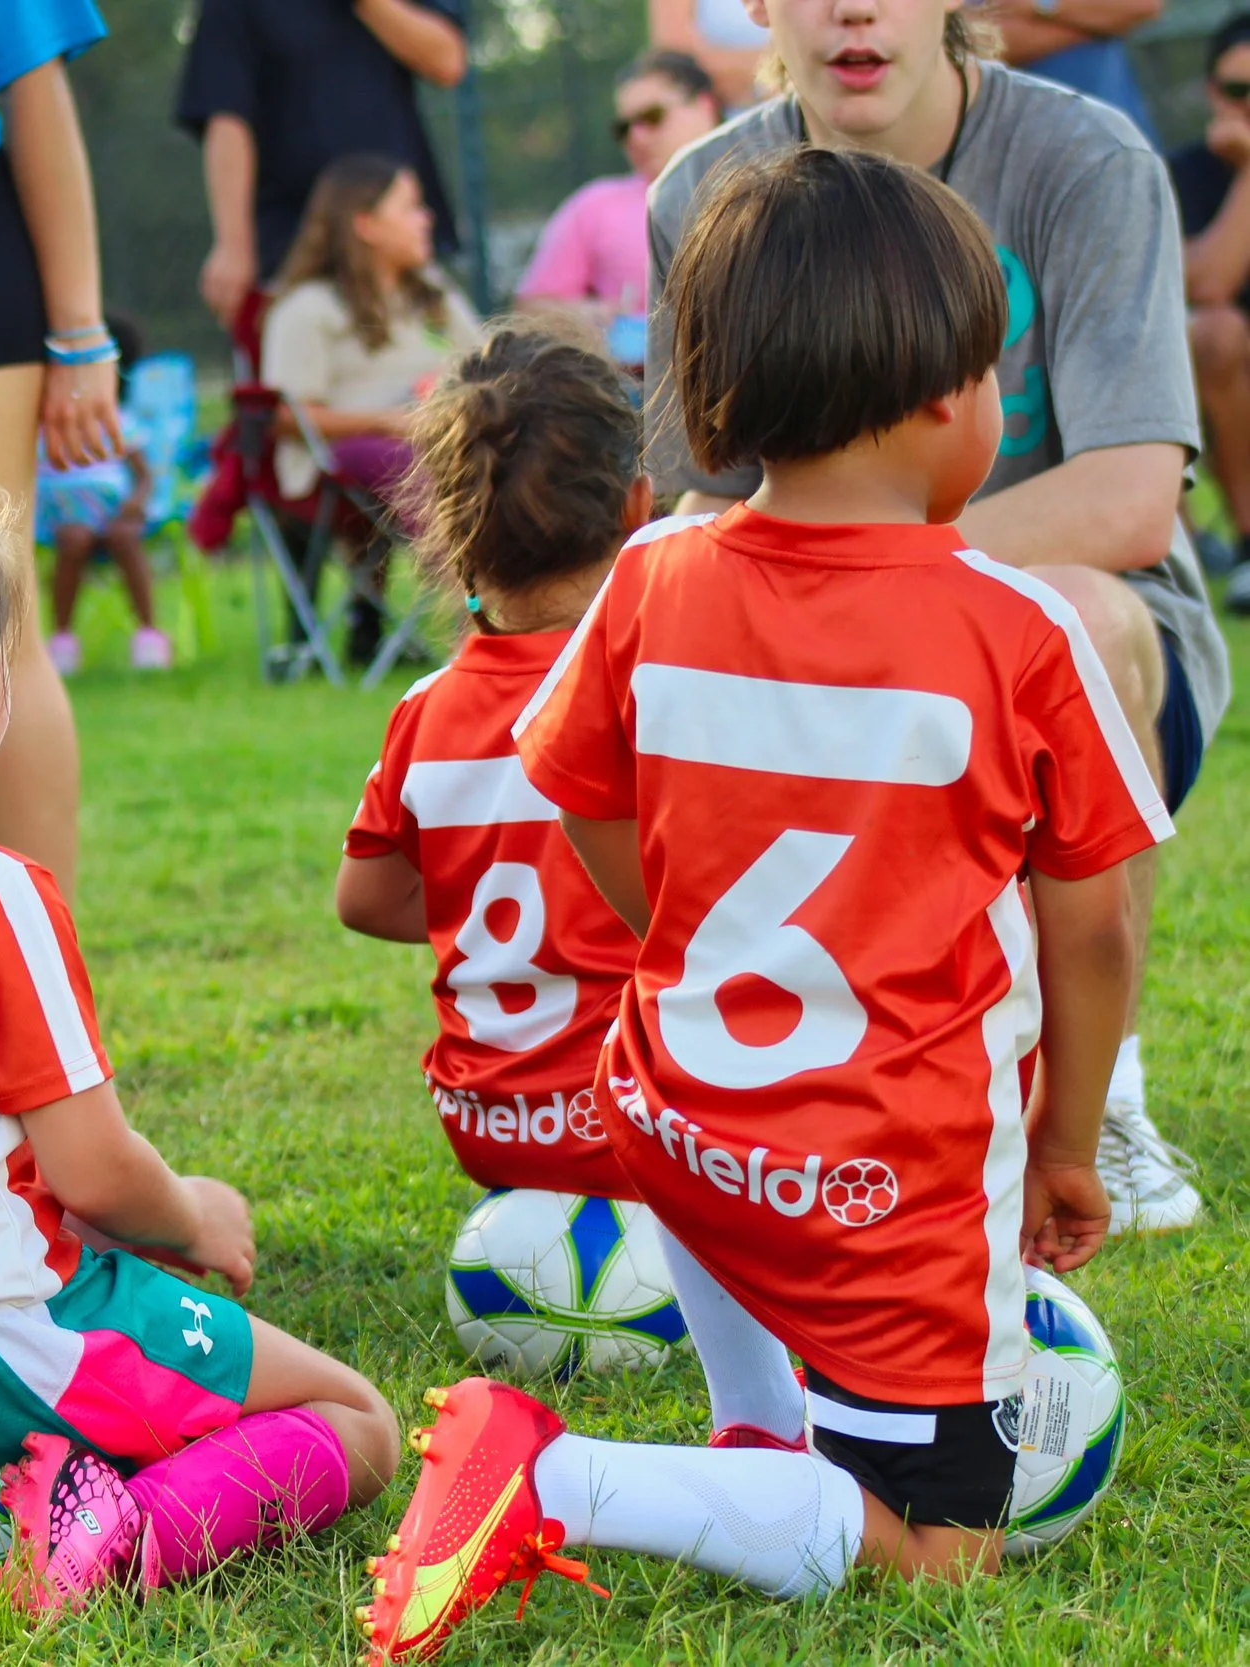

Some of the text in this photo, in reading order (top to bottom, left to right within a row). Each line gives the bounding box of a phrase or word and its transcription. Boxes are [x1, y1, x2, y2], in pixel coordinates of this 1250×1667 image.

[446, 862, 578, 1052] 8
[657, 829, 869, 1089] 6
[425, 1070, 564, 1145] pfield
